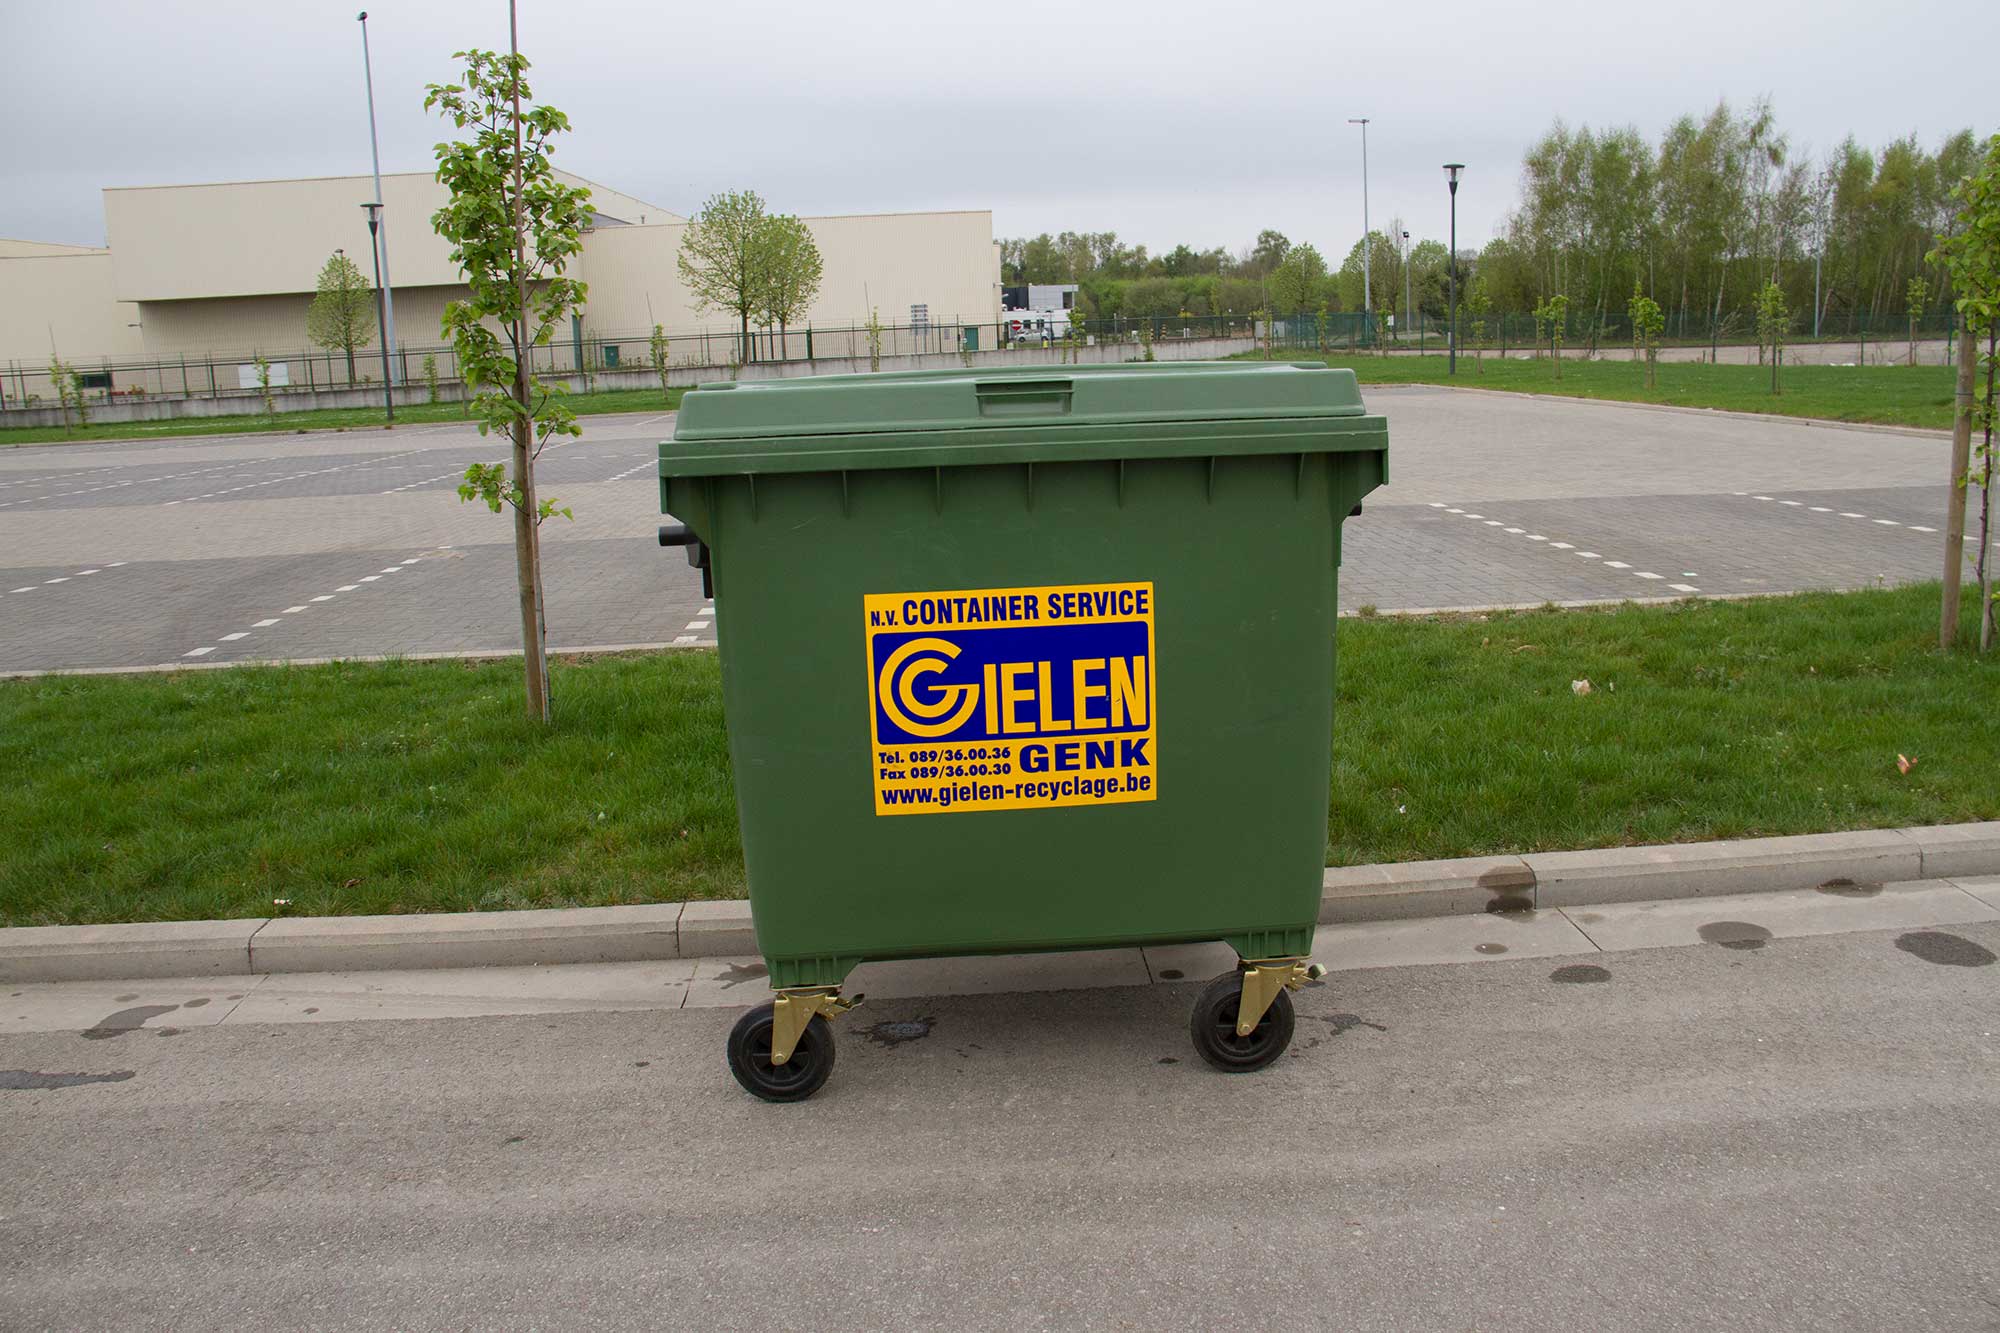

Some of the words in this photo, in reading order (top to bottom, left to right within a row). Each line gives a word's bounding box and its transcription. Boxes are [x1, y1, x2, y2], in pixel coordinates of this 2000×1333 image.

[871, 610, 898, 626] N.V.
[903, 595, 1039, 625] CONTAINER
[1048, 589, 1149, 619] SERVICE
[879, 637, 1146, 737] GIELEN
[879, 751, 905, 764] Tel.
[909, 747, 1011, 763] 089/36.00.36
[880, 768, 906, 780] Fax
[910, 763, 1011, 779] 089/36.00.30
[1019, 738, 1150, 774] GENK
[882, 773, 1151, 806] www.gielen-recyclage.be
